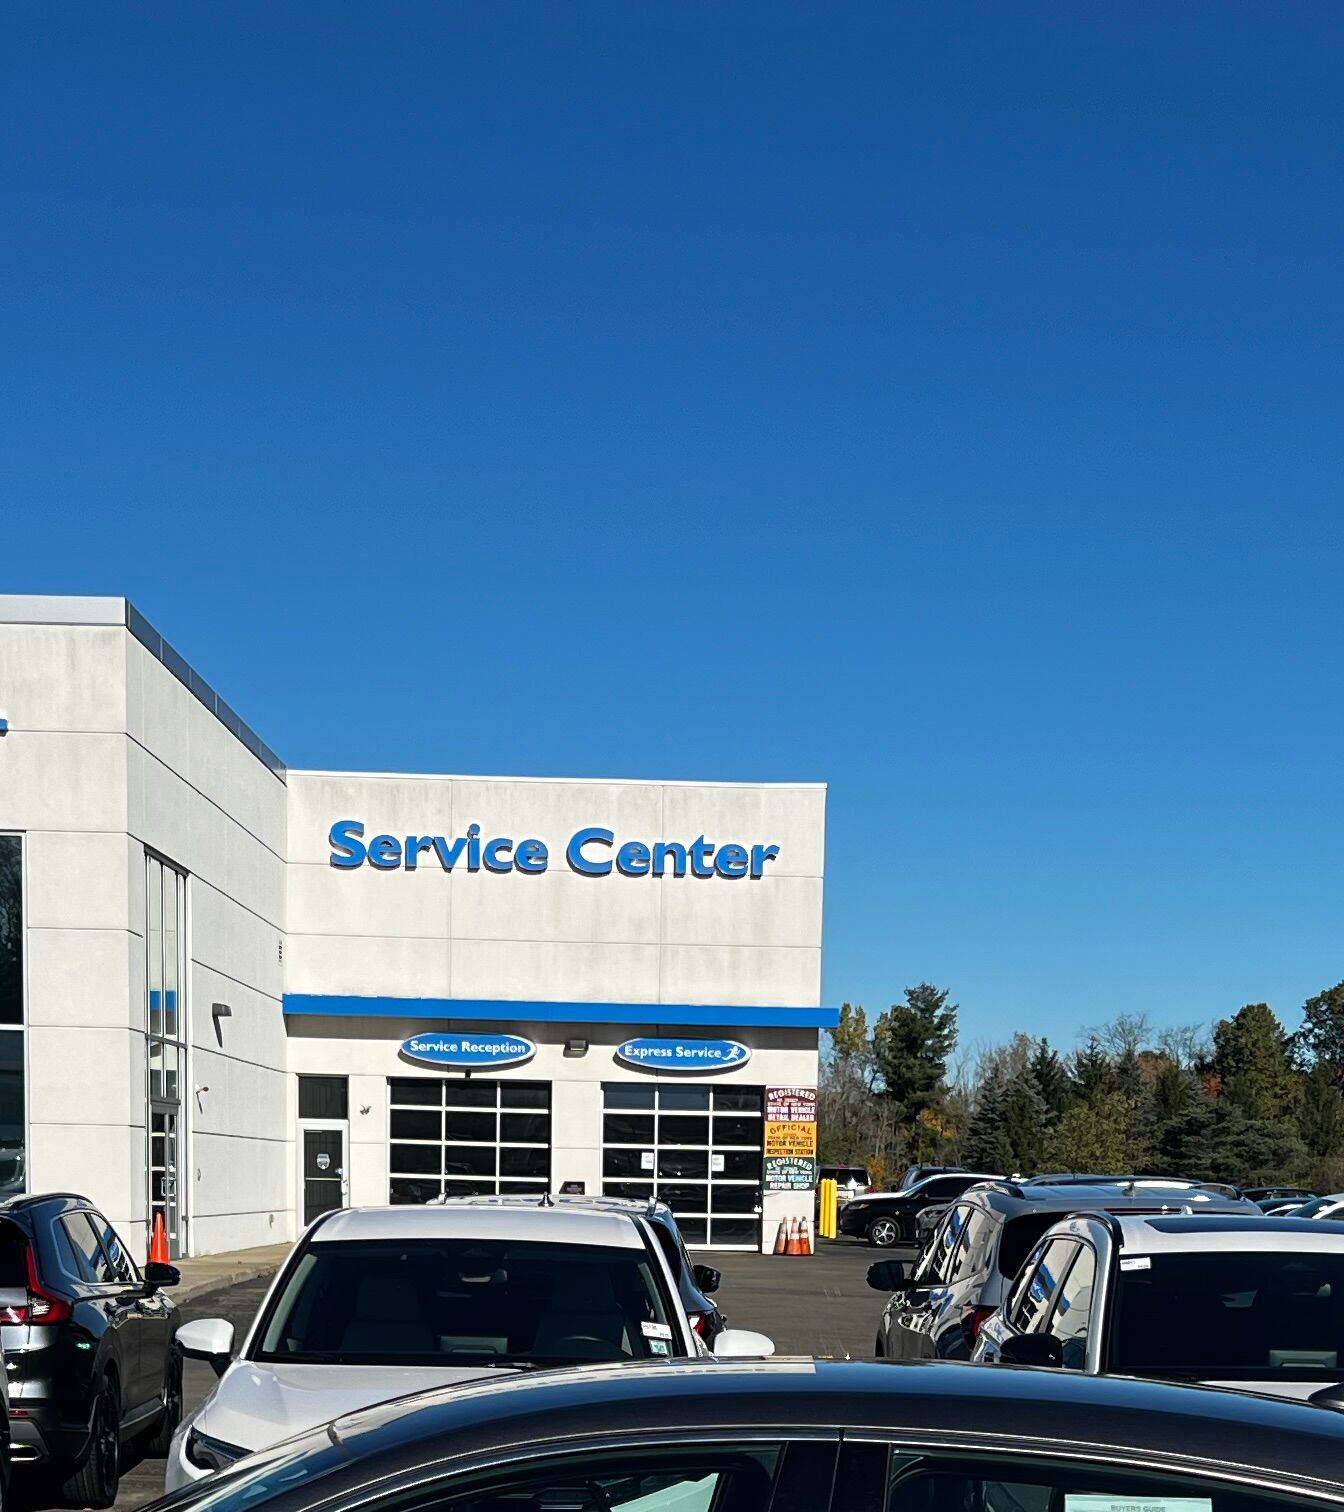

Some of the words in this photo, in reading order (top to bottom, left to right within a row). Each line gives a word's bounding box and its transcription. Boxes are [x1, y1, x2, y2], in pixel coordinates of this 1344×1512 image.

[328, 820, 549, 875] Service
[565, 827, 781, 880] Center
[409, 1039, 458, 1053] Service
[461, 1041, 526, 1056] Reception
[624, 1045, 673, 1059] Express
[675, 1046, 722, 1059] Service
[768, 1088, 816, 1101] REGISTERED
[769, 1124, 812, 1135] OFFICIAL
[766, 1158, 813, 1170] REGISTERED
[1110, 1504, 1142, 1512] BUYERS
[1143, 1505, 1167, 1512] GUIDE
